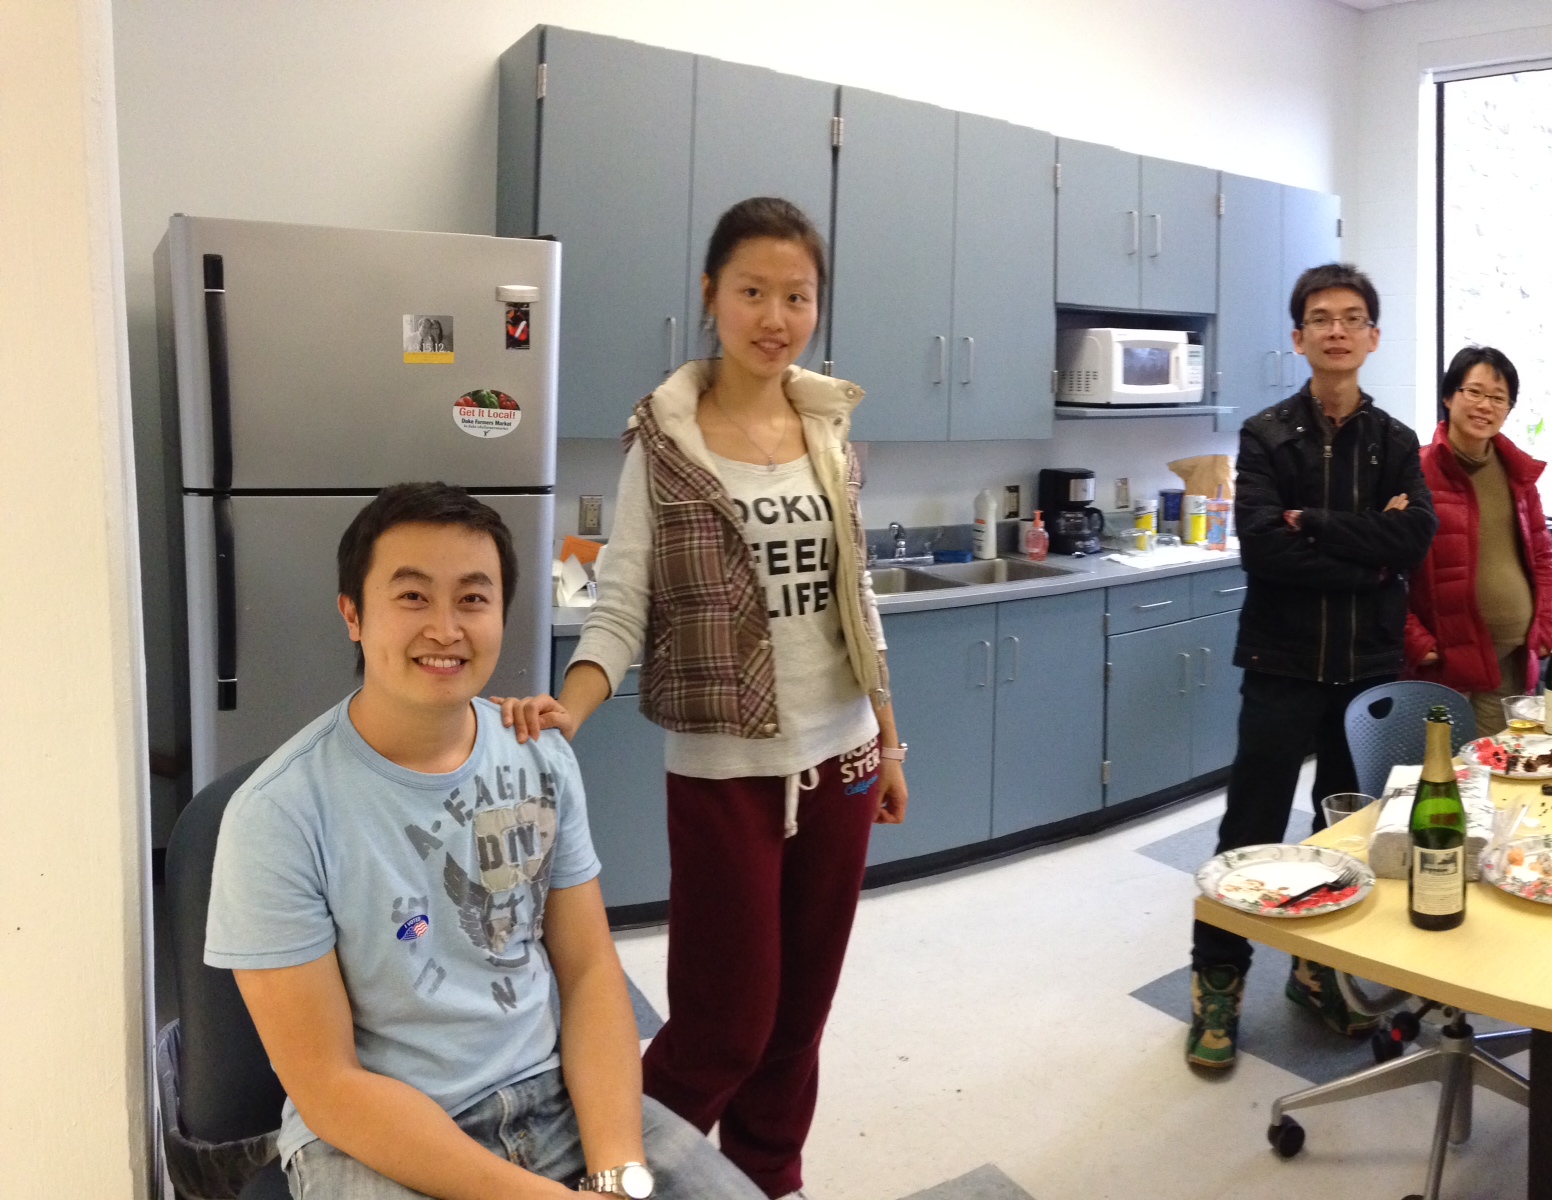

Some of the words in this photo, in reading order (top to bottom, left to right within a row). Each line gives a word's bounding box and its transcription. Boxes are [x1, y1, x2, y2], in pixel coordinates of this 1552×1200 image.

[459, 407, 475, 417] Get
[478, 409, 485, 418] It
[488, 409, 516, 419] Local!
[840, 748, 881, 784] STER
[407, 916, 422, 927] VOTED
